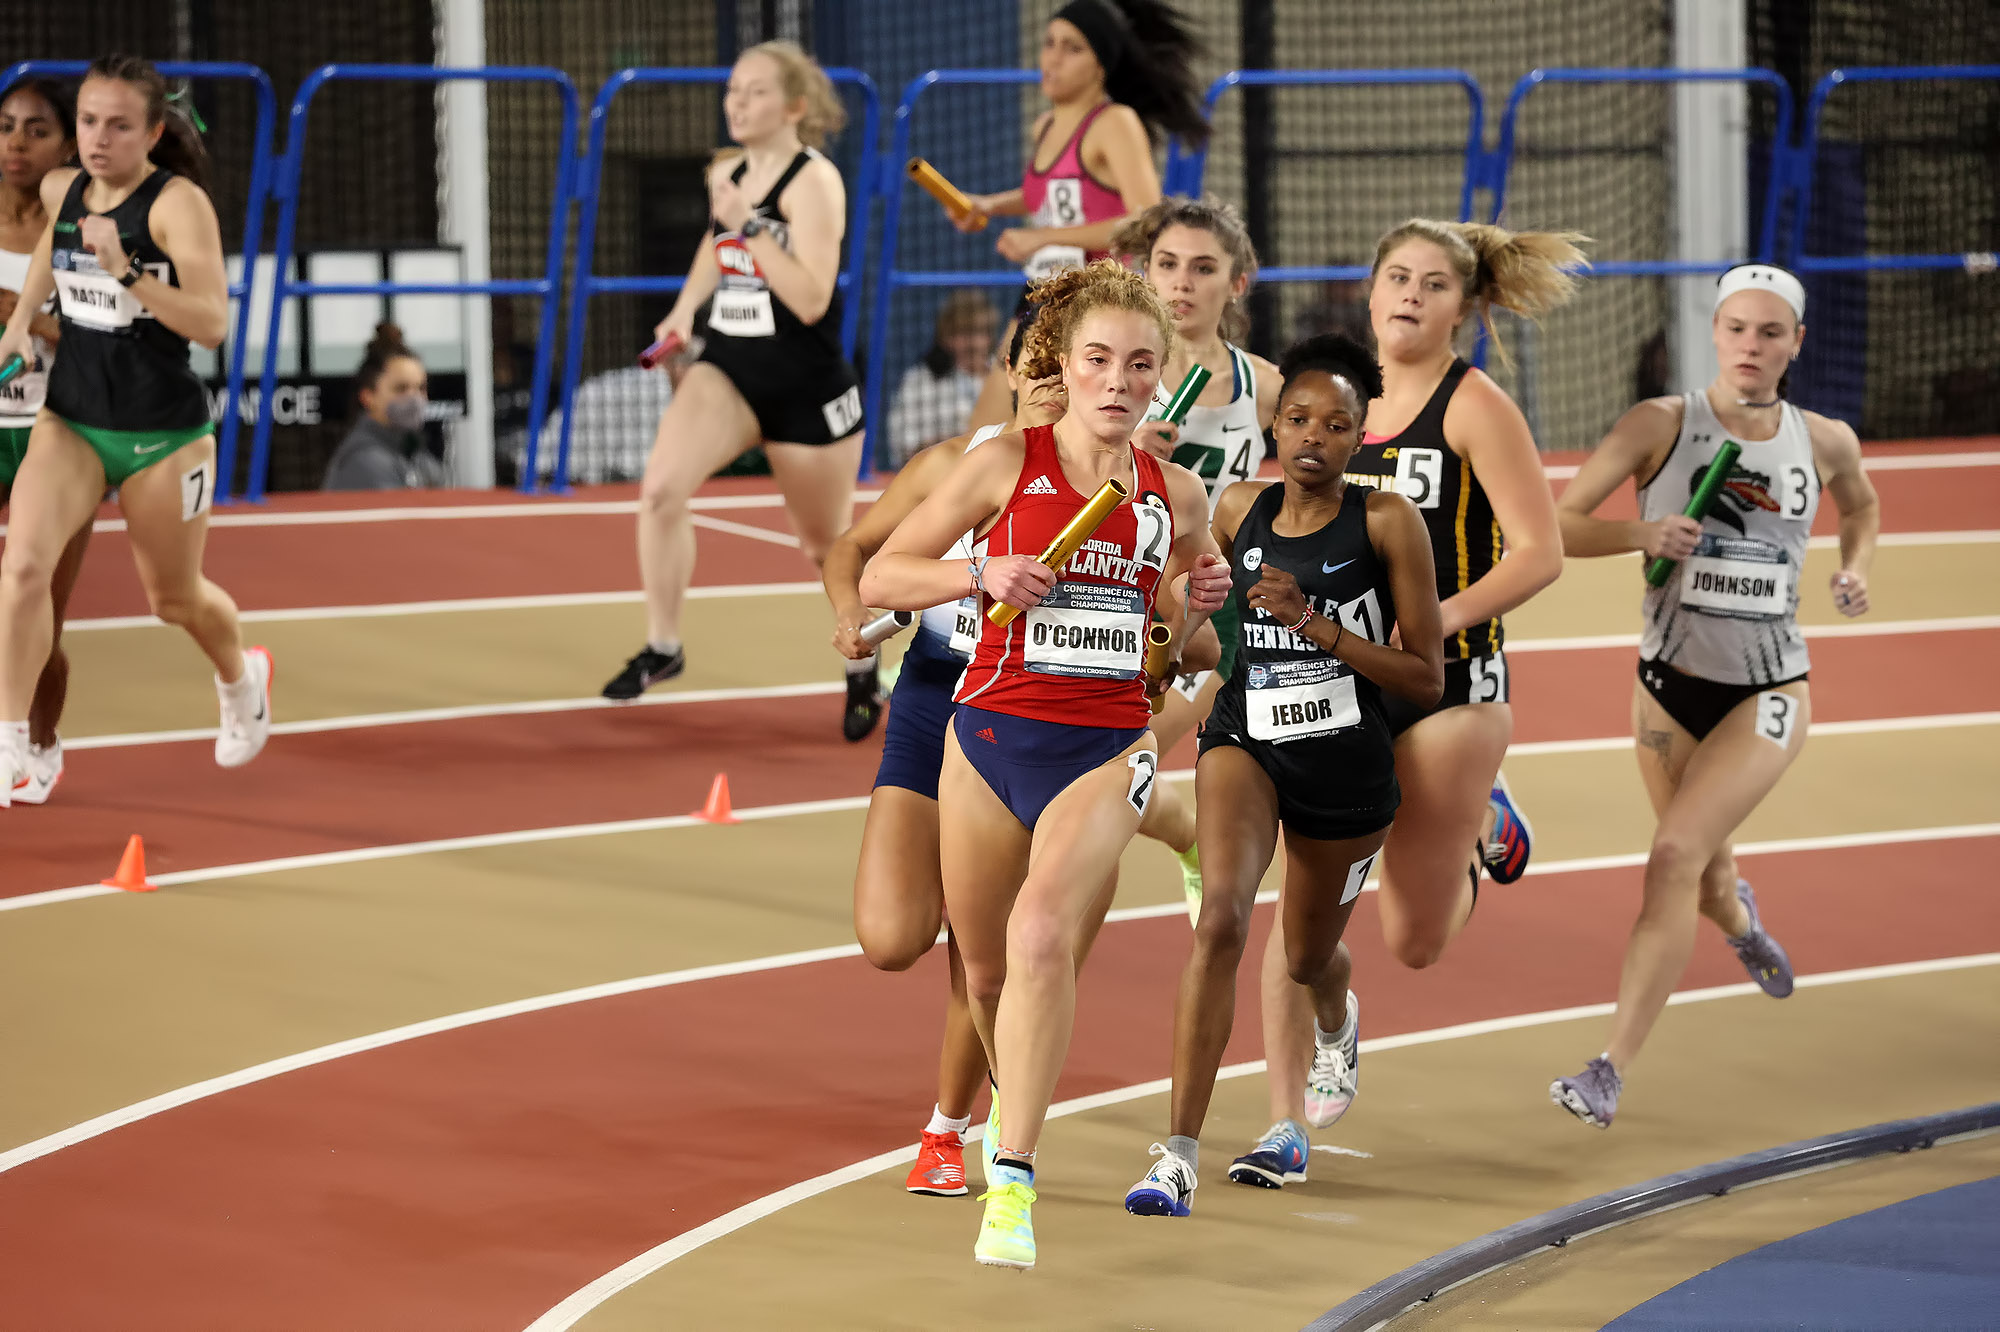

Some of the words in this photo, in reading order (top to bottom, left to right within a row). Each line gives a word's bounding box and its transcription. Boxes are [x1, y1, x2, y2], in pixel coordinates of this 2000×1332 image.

[1055, 186, 1075, 221] 8
[69, 286, 117, 310] MASTIN
[0, 385, 24, 400] AN
[1229, 439, 1251, 481] 4
[190, 469, 204, 512] 7
[1023, 486, 1057, 495] adidas
[1408, 454, 1432, 503] 5
[1791, 467, 1808, 516] 3
[1079, 538, 1122, 556] LORIDA
[1142, 508, 1164, 565] 2
[1062, 551, 1143, 586] LANTIC
[1063, 584, 1122, 597] CONFERENCE
[1122, 589, 1139, 599] USA
[1693, 572, 1776, 597] JOHNSON
[1071, 600, 1132, 612] CHAMPIONSHIPS
[1094, 595, 1112, 603] TRACK
[1353, 599, 1376, 643] 1
[1033, 622, 1137, 654] O'CONNOR
[1244, 622, 1326, 652] TENNES
[1047, 664, 1087, 674] BIRMINGHAM
[1087, 667, 1120, 676] CROSSPLEX
[1270, 661, 1326, 674] CONFERENCE
[1278, 672, 1339, 687] CHAMPIONSHIPS
[1298, 669, 1317, 677] TRACK
[1272, 698, 1333, 727] JEBOR
[1766, 696, 1788, 739] 3
[1271, 733, 1307, 746] BIRMINGHAM
[1307, 729, 1340, 739] CROSSPLEX
[1131, 753, 1155, 811] 2
